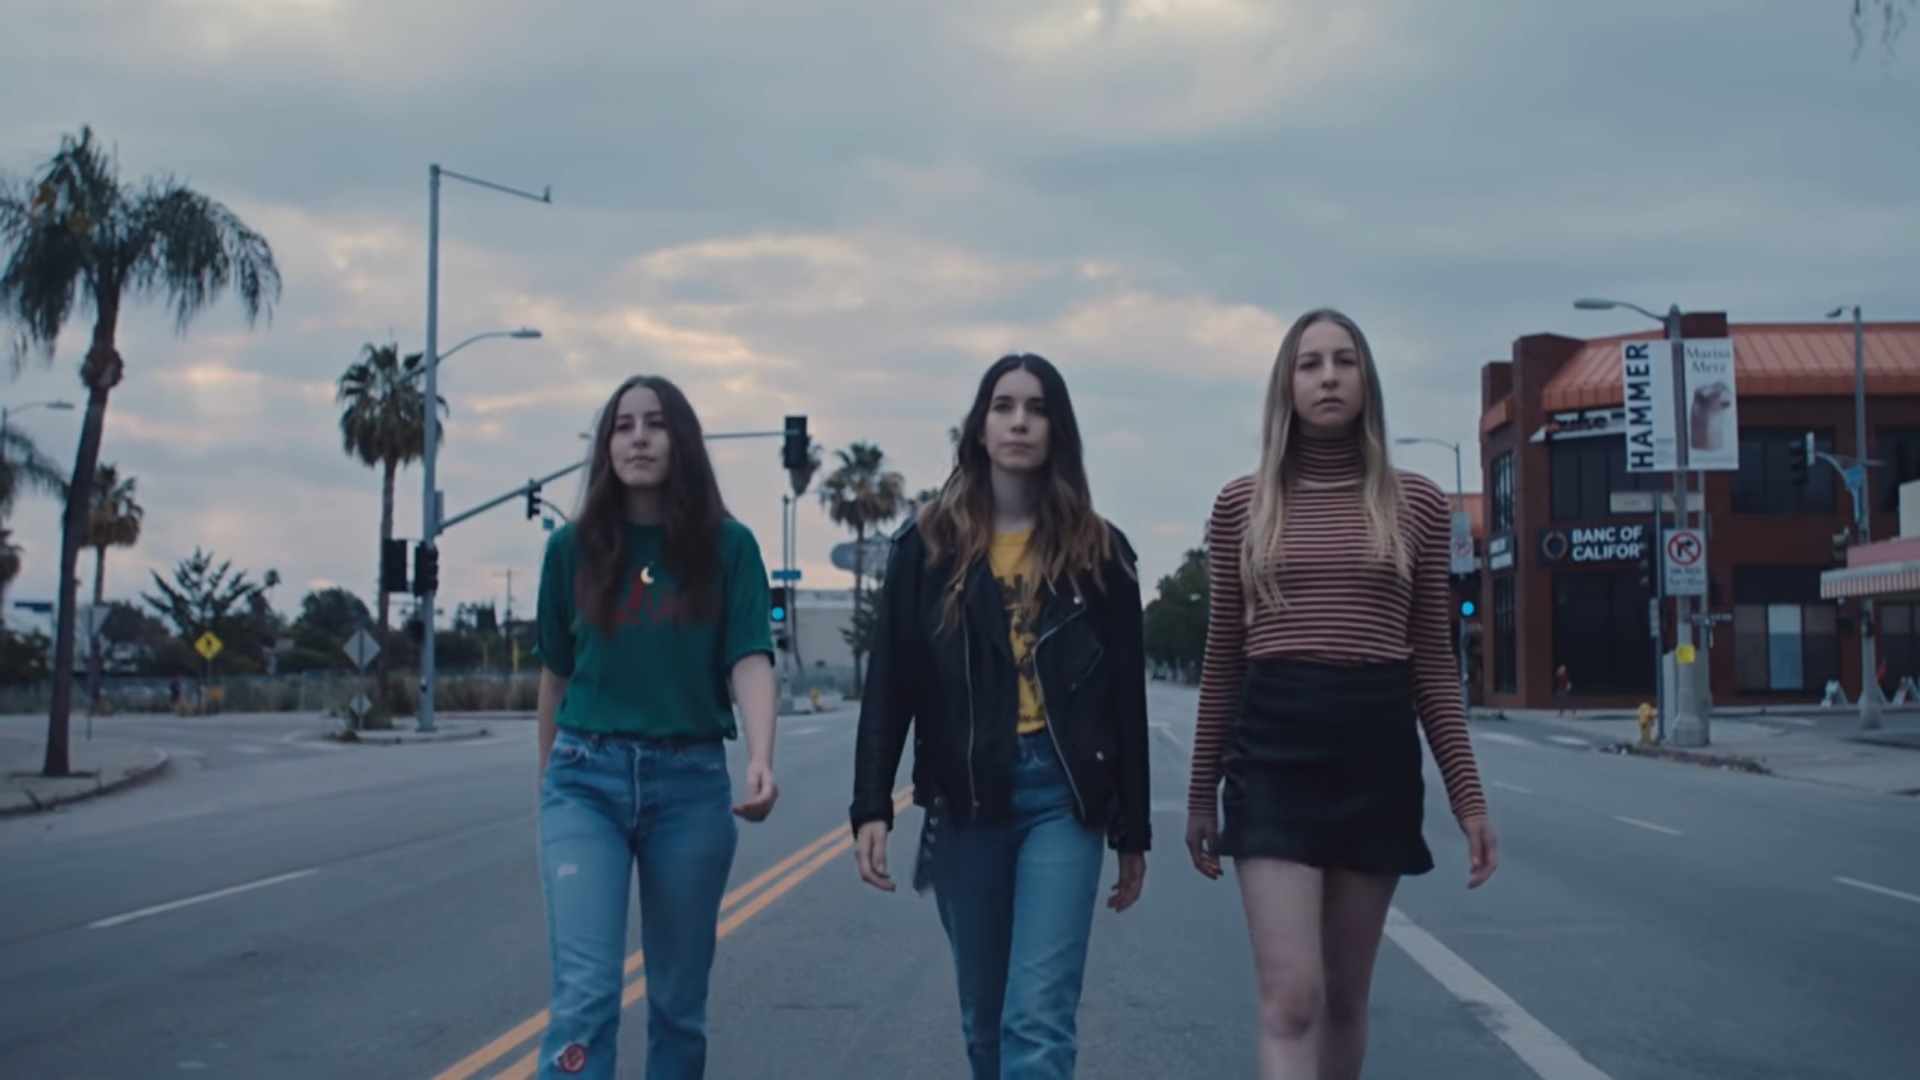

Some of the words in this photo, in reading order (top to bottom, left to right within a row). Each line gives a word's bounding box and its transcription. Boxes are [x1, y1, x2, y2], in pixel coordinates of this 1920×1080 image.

[1626, 343, 1654, 468] HAMMER
[1572, 527, 1616, 544] BANC
[1620, 525, 1643, 542] OF
[1572, 542, 1646, 561] CALIFOR
